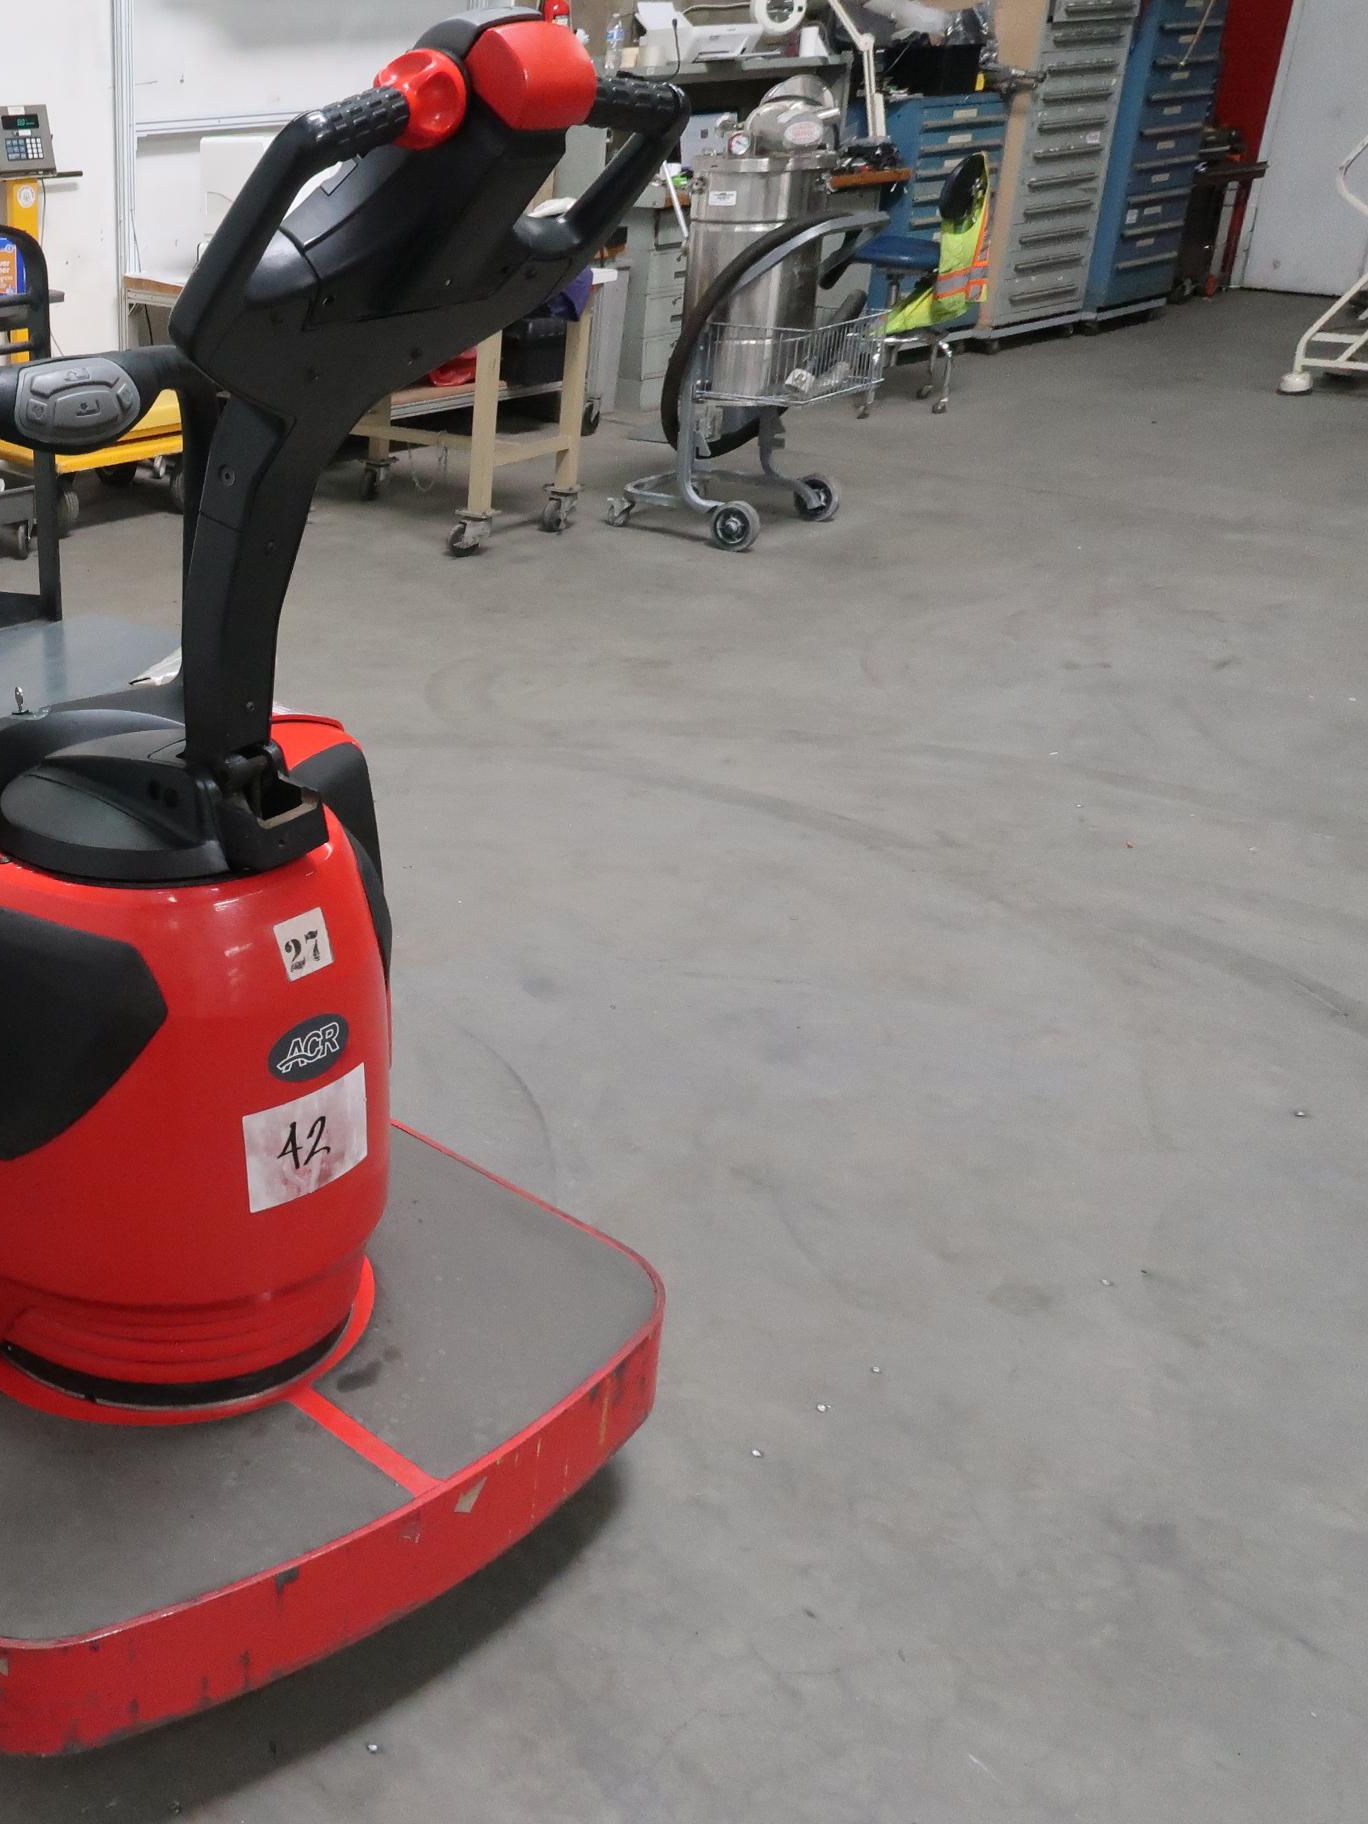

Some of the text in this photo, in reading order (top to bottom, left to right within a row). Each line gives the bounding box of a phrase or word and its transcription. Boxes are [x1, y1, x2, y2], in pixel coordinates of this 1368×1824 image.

[284, 929, 321, 972] 27
[276, 1021, 340, 1074] ACR
[276, 1115, 331, 1170] 42
